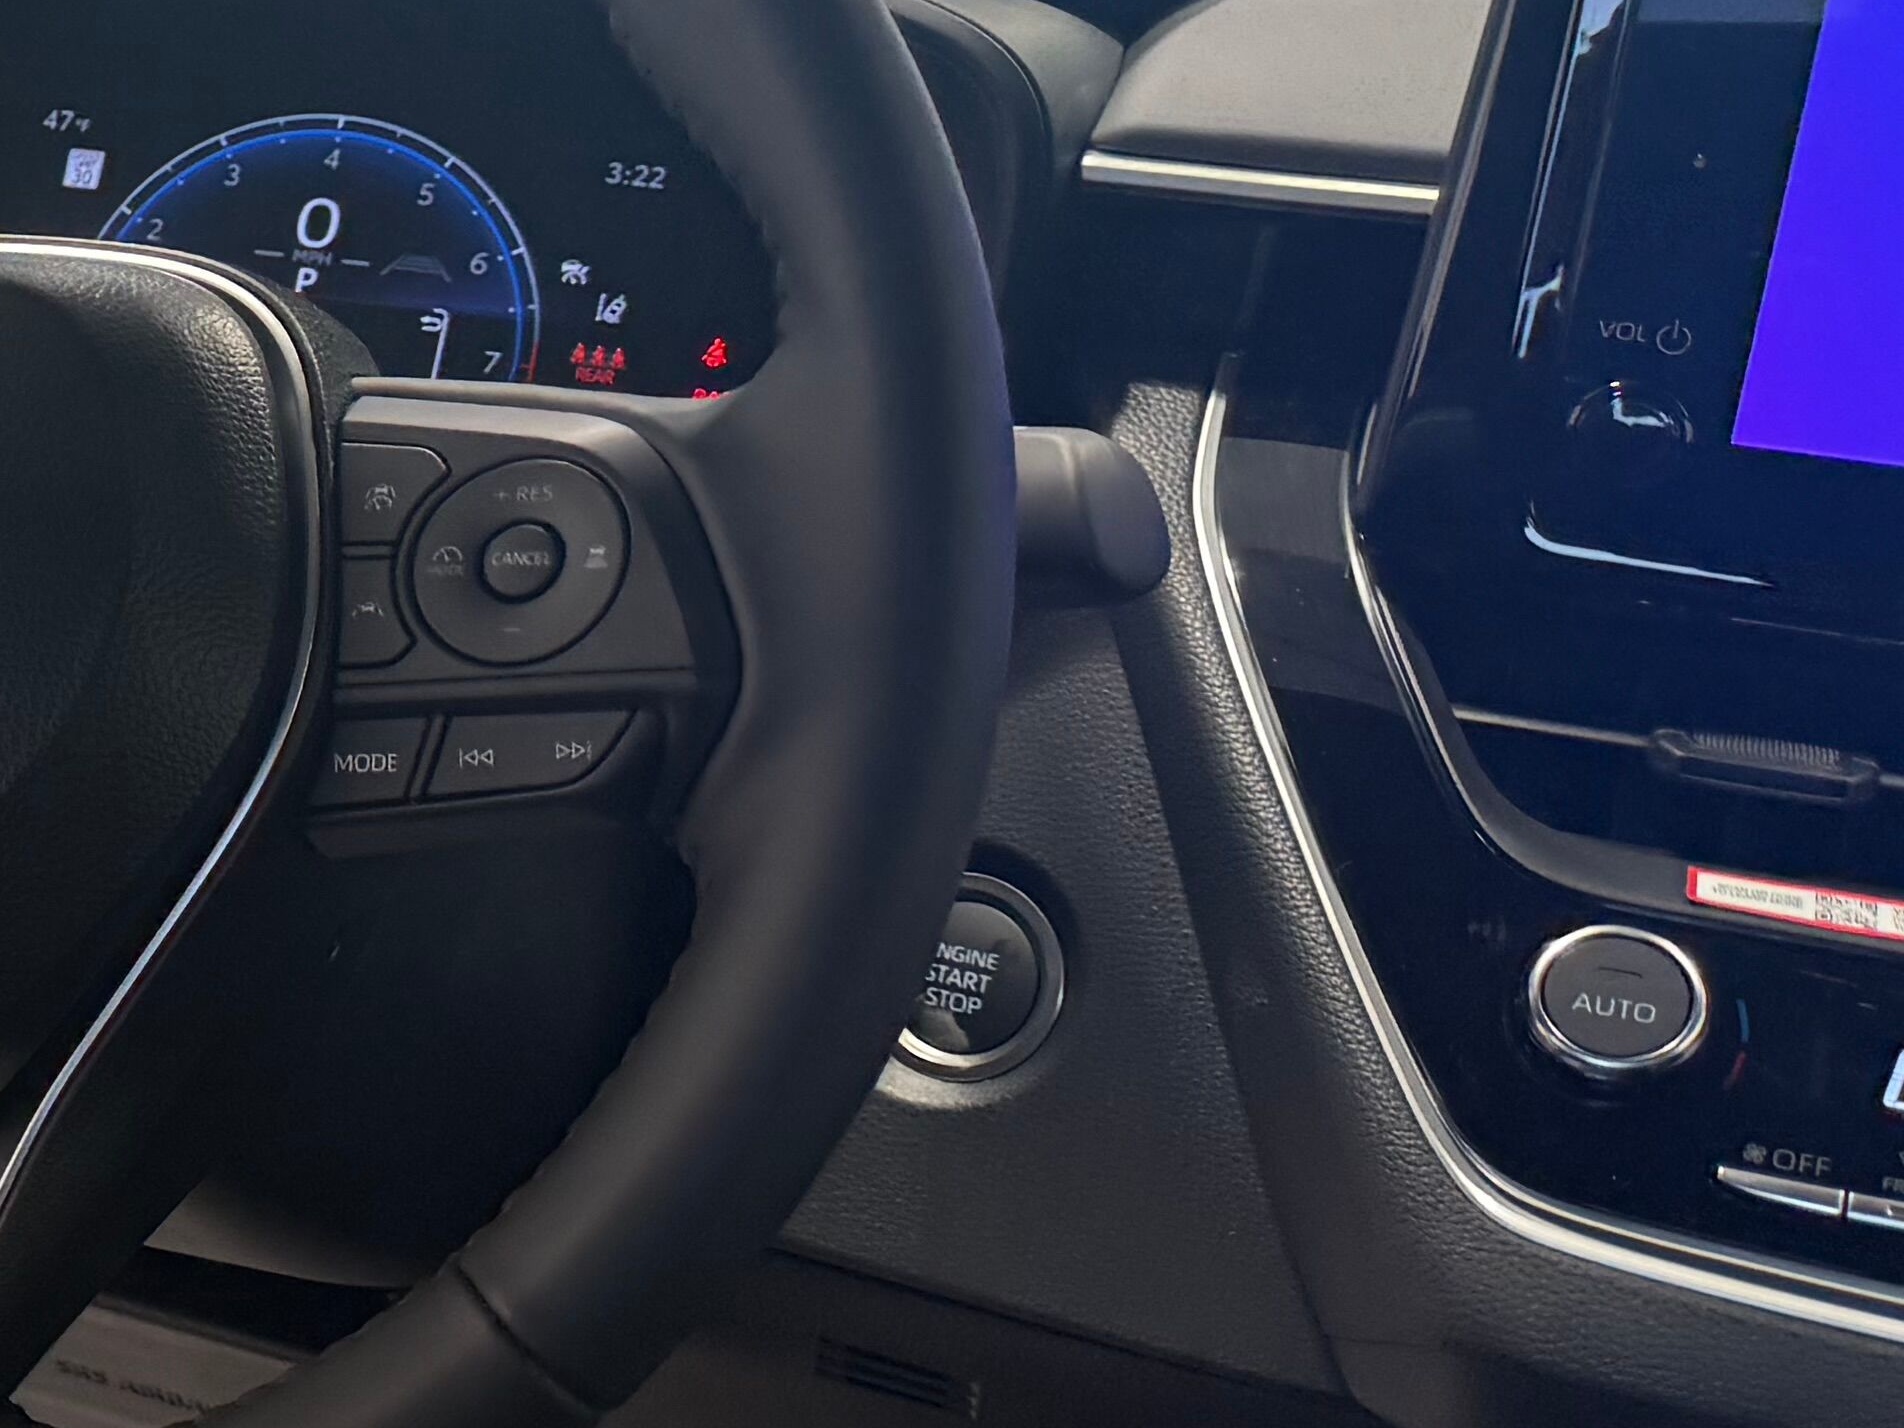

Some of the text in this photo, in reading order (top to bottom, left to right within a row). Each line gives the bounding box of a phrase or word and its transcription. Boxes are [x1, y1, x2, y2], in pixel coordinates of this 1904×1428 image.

[324, 149, 341, 170] 4
[223, 163, 241, 186] 3
[604, 161, 666, 189] 3:22
[417, 183, 436, 206] 5
[146, 218, 164, 241] 2
[469, 252, 490, 275] 6
[295, 267, 319, 293] P
[1599, 319, 1646, 343] VOL
[483, 350, 503, 374] 7
[334, 752, 399, 773] MODE
[935, 942, 1001, 971] NGINE
[923, 987, 983, 1014] STOP
[1572, 992, 1656, 1024] AUTO
[1771, 1148, 1833, 1177] OFF
